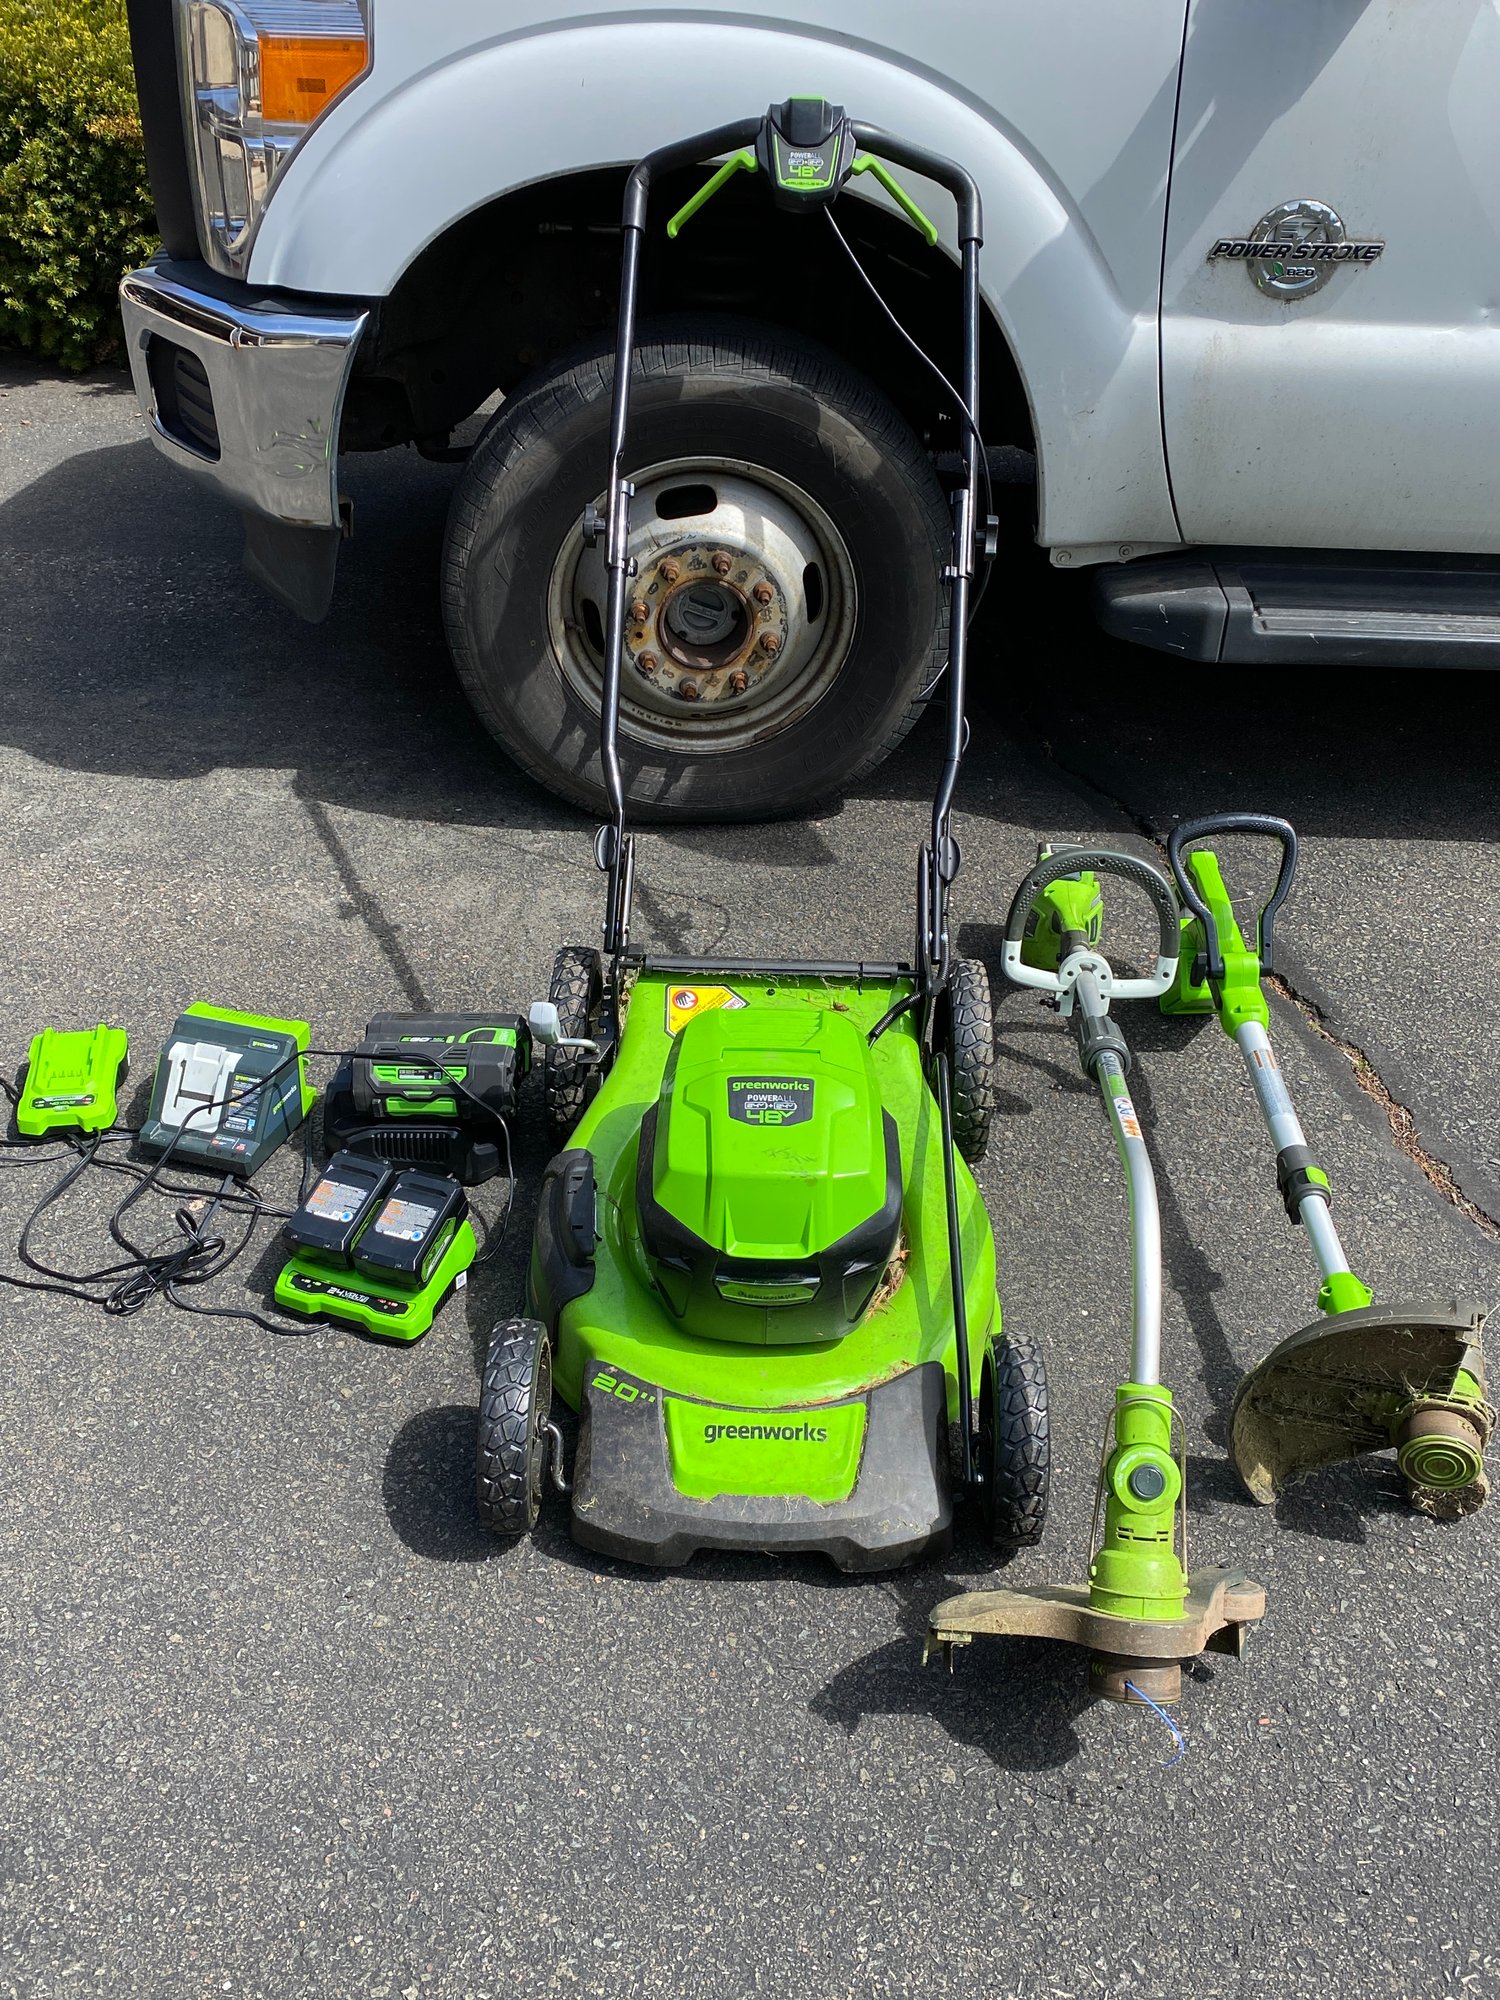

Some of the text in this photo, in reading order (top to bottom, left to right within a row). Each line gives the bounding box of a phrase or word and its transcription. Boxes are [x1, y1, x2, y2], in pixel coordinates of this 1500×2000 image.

[790, 151, 821, 159] POWERALL
[789, 166, 822, 177] 48V
[1212, 241, 1383, 262] POWER STROKE
[1285, 266, 1316, 278] B20
[732, 1081, 810, 1092] greenworks
[747, 1094, 795, 1102] POWERALL
[746, 1110, 795, 1124] 48V
[704, 1422, 827, 1444] greenworks
